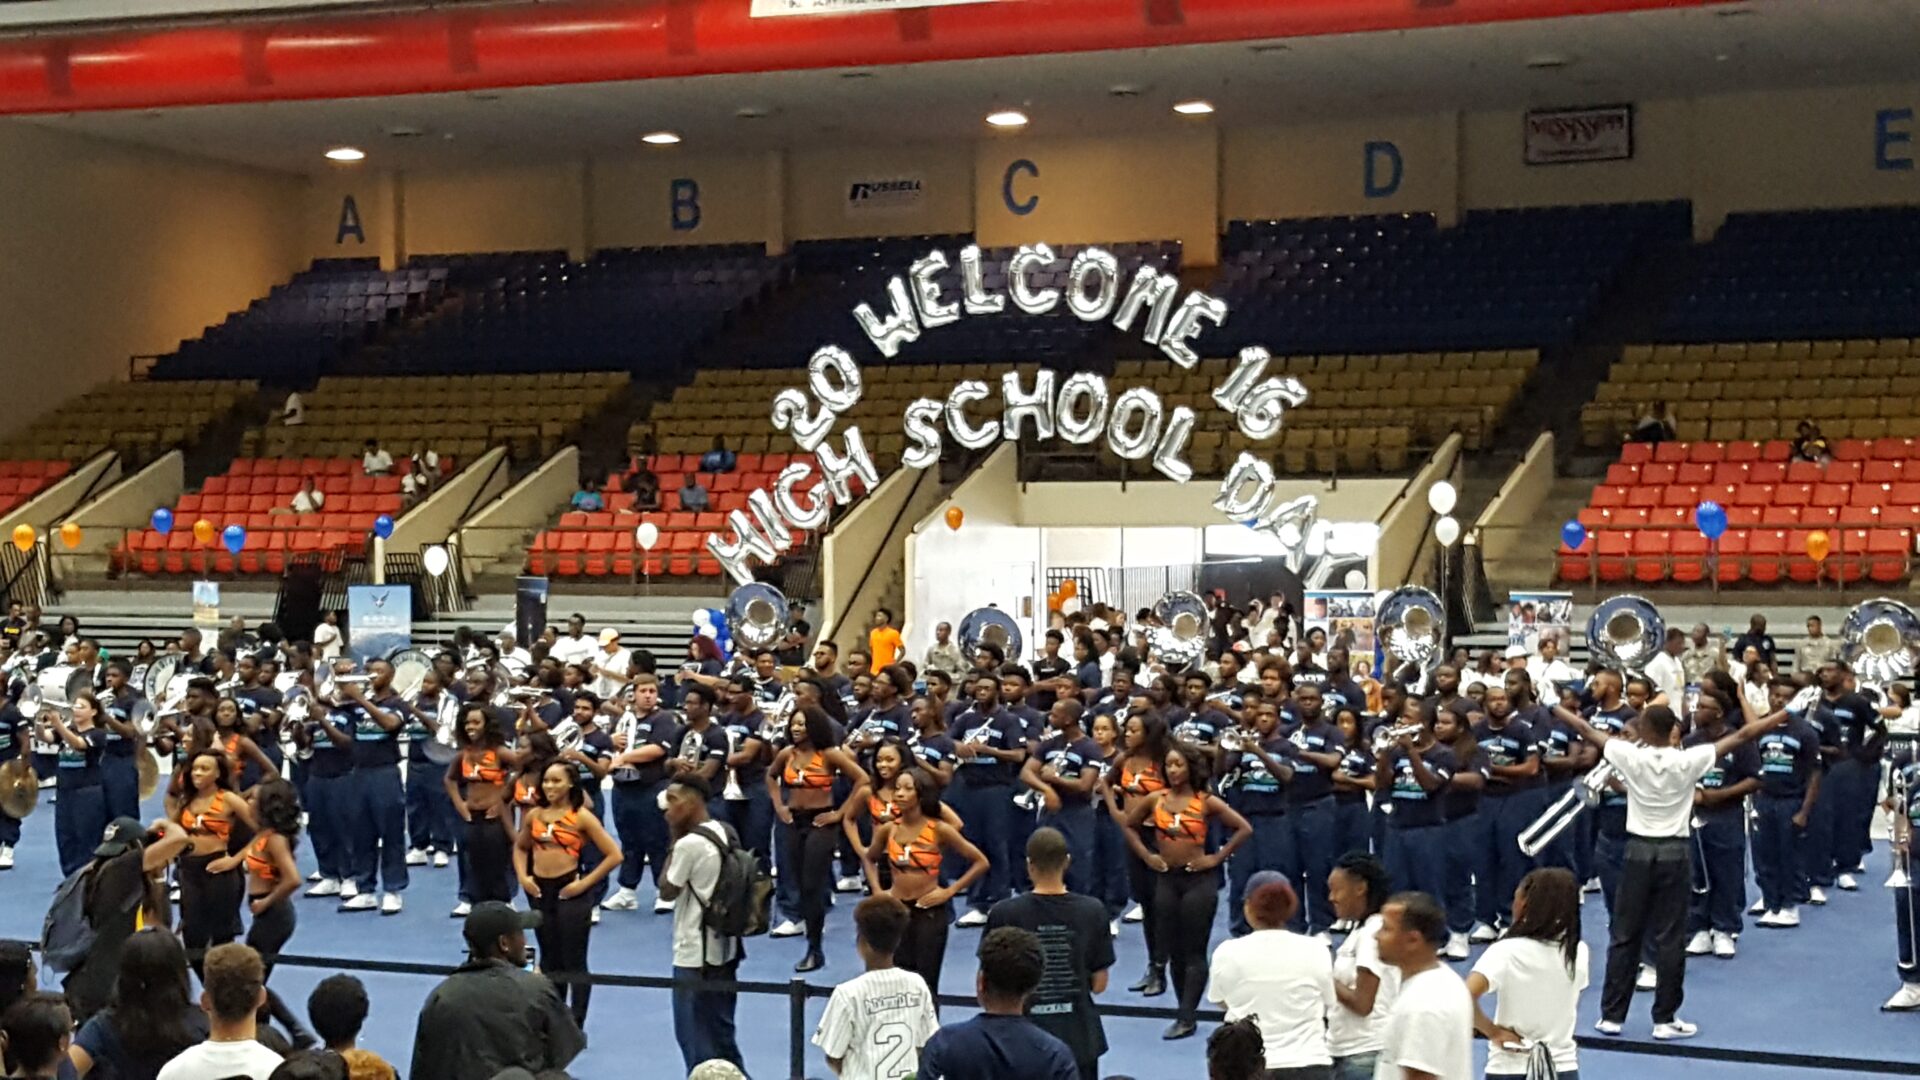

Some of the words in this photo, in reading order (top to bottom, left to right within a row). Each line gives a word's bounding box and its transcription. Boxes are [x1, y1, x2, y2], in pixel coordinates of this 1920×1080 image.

[1876, 107, 1914, 170] E
[1003, 159, 1040, 215] C
[1364, 141, 1402, 198] D
[336, 194, 365, 244] A
[671, 178, 701, 231] B
[771, 343, 864, 452] 20
[852, 241, 1228, 369] WELCOME
[1211, 344, 1309, 441] 16
[706, 425, 880, 587] HIGH
[900, 368, 1196, 484] SCHOOL
[1212, 451, 1367, 590] DAY
[873, 1021, 914, 1080] 2
